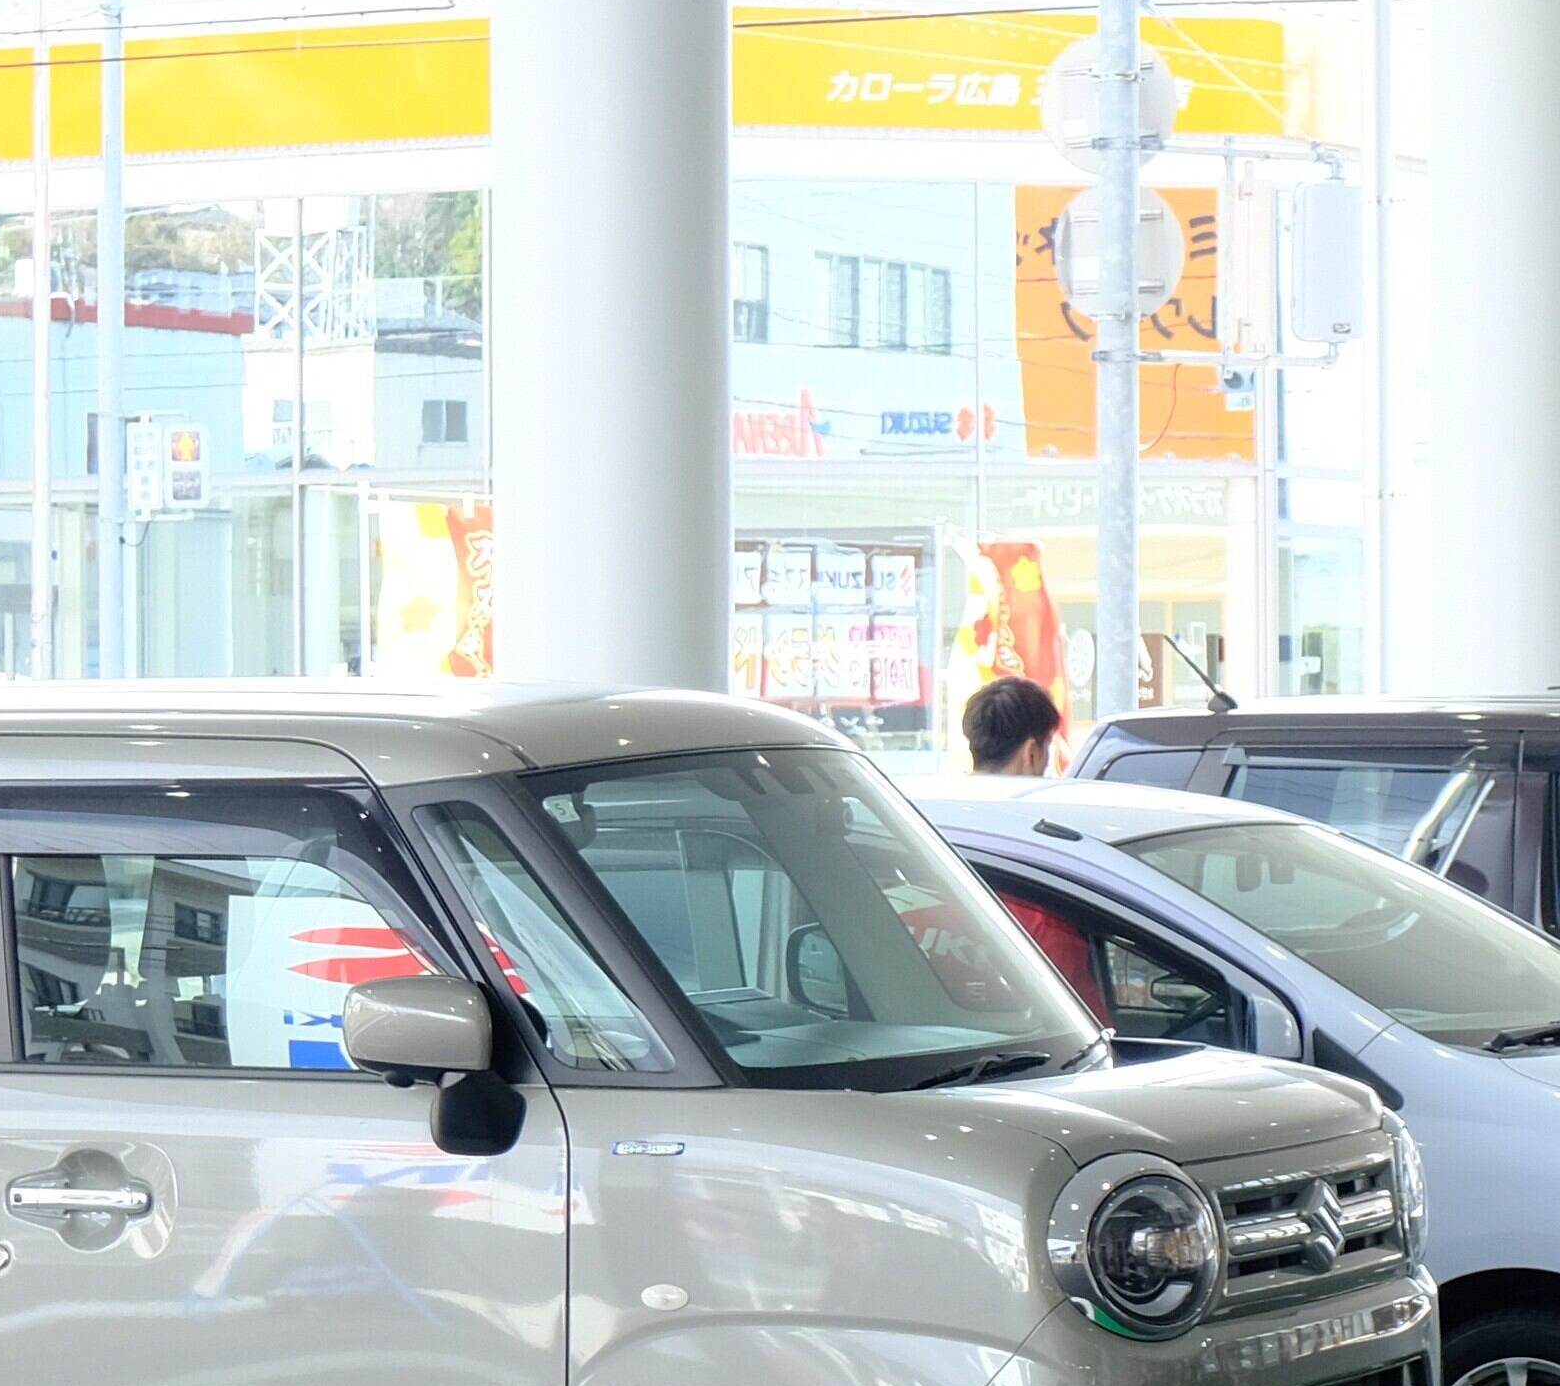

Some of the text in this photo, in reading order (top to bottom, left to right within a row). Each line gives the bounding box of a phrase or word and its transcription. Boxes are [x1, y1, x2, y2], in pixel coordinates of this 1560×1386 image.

[826, 71, 1020, 107] カローラ広島
